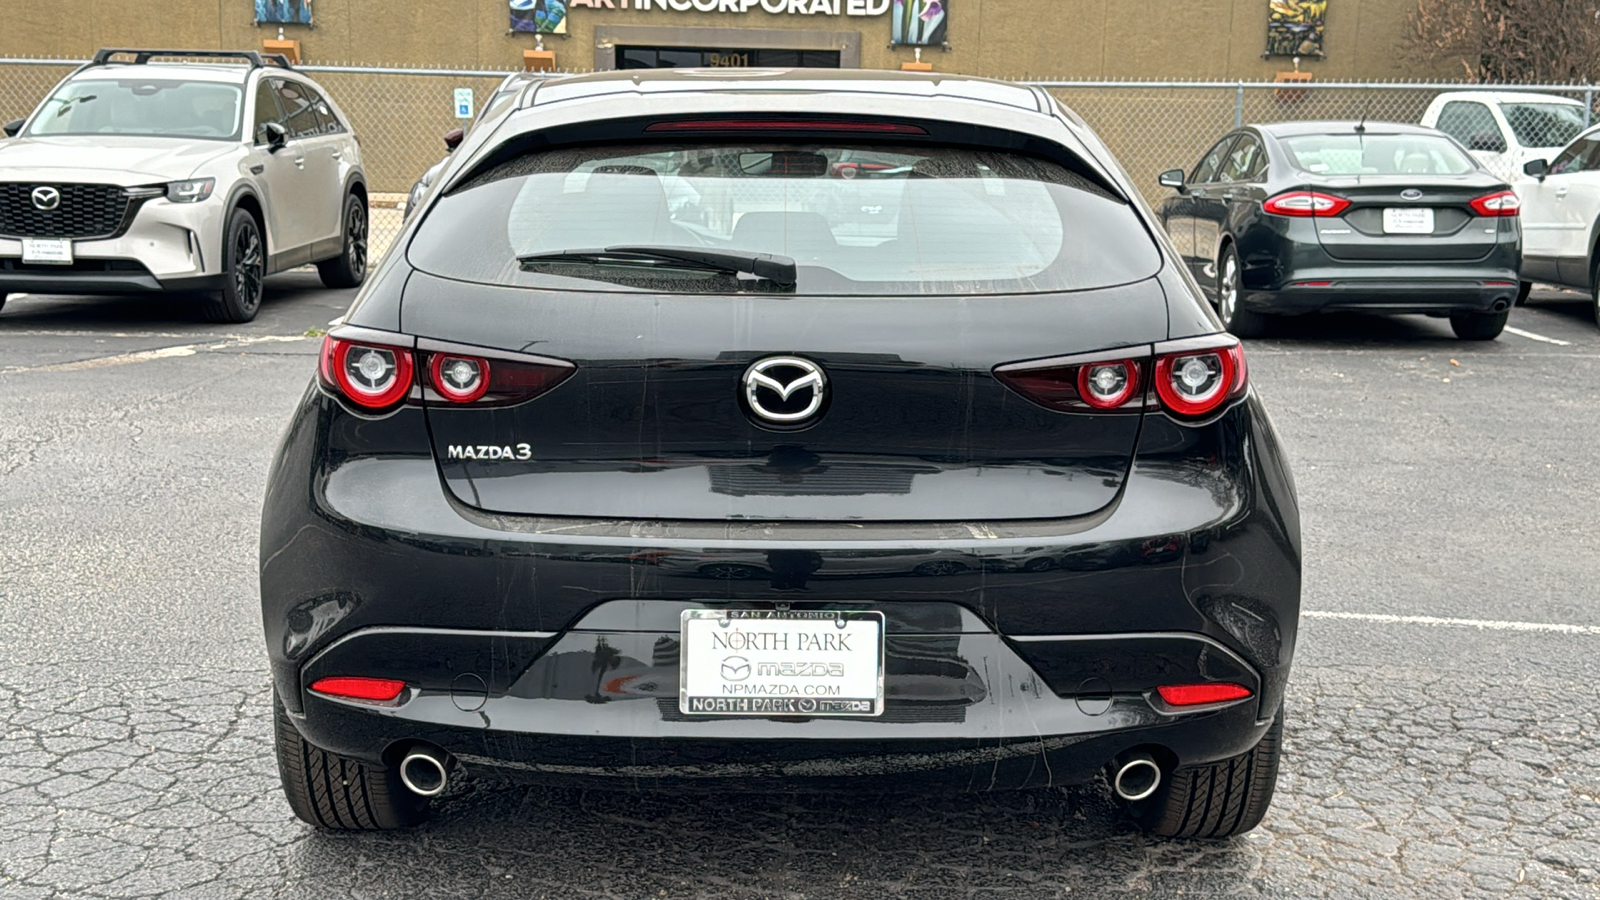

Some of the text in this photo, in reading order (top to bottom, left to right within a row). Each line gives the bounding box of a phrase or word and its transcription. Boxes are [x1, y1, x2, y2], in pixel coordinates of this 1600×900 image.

[569, 0, 890, 15] ORPORATED
[710, 53, 748, 67] 9401
[730, 611, 760, 619] SAN
[712, 631, 852, 651] NORTH PARK
[722, 684, 841, 695] NPMAZDA.COM
[692, 698, 748, 711] NORTH
[752, 699, 796, 712] PARK
